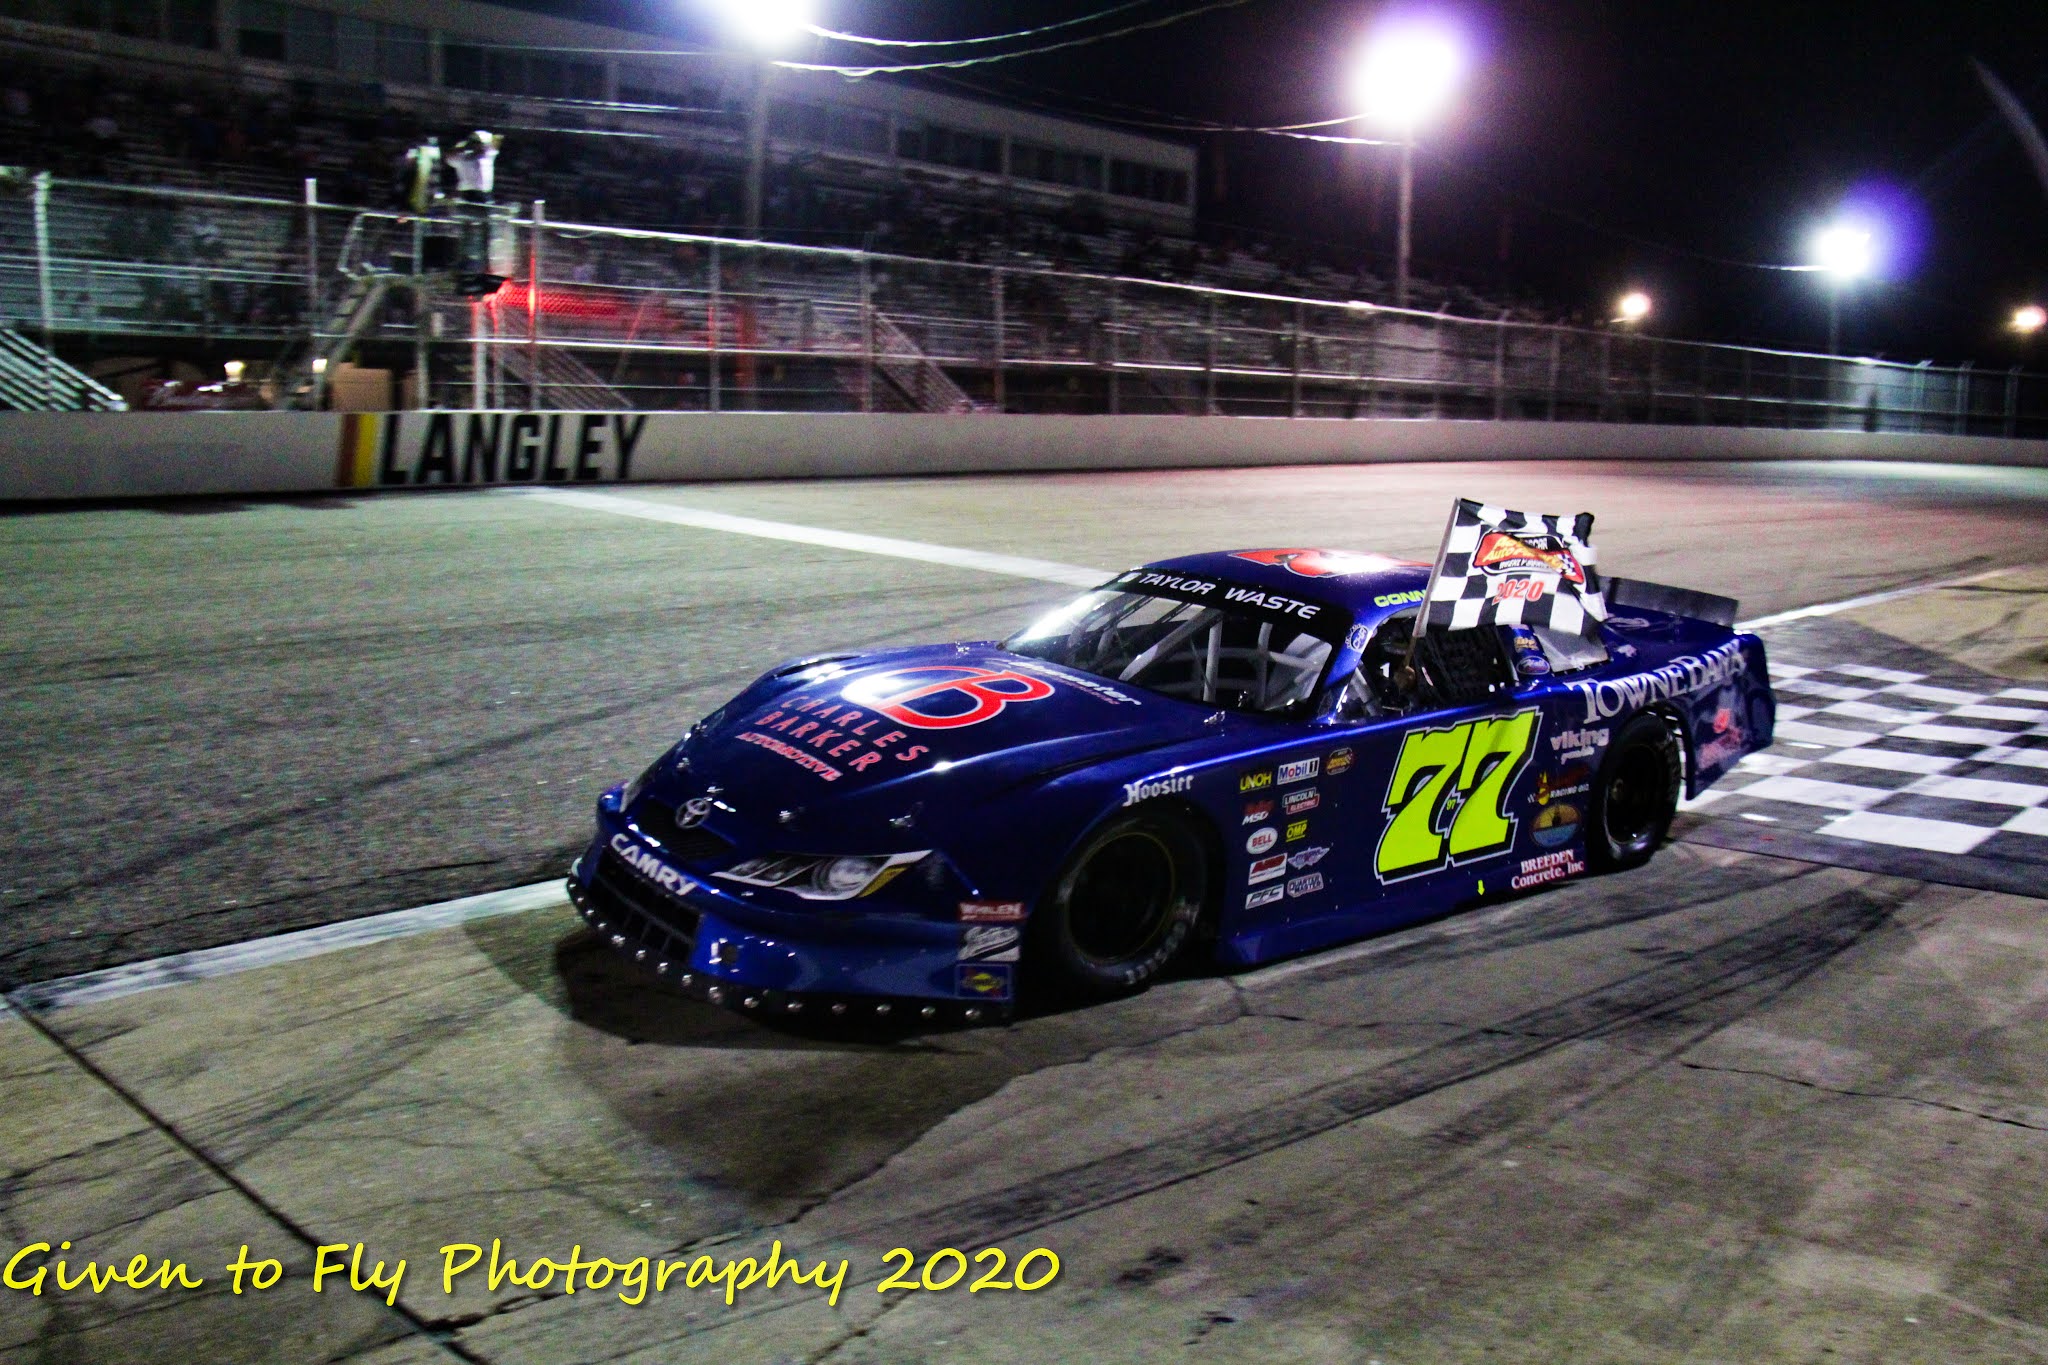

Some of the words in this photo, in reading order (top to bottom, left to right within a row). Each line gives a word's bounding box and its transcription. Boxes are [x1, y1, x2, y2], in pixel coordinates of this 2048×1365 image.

[381, 414, 647, 483] LANGLEY
[1139, 573, 1216, 596] TAYLOR
[1225, 587, 1321, 620] WASTE
[1491, 579, 1545, 606] 2020
[781, 695, 930, 762] CHARLES
[1551, 728, 1609, 750] viking
[754, 710, 882, 772] BARKER
[1240, 772, 1271, 790] UNOH
[1279, 761, 1308, 778] Mobil
[1285, 791, 1314, 805] LINCOLN
[1373, 705, 1544, 886] 77
[1243, 811, 1269, 824] MSD
[1252, 834, 1272, 847] BELL
[1287, 824, 1307, 839] OMP
[610, 833, 698, 896] CAMRY
[1520, 849, 1575, 875] BREEDEN
[1566, 860, 1585, 876] Inc
